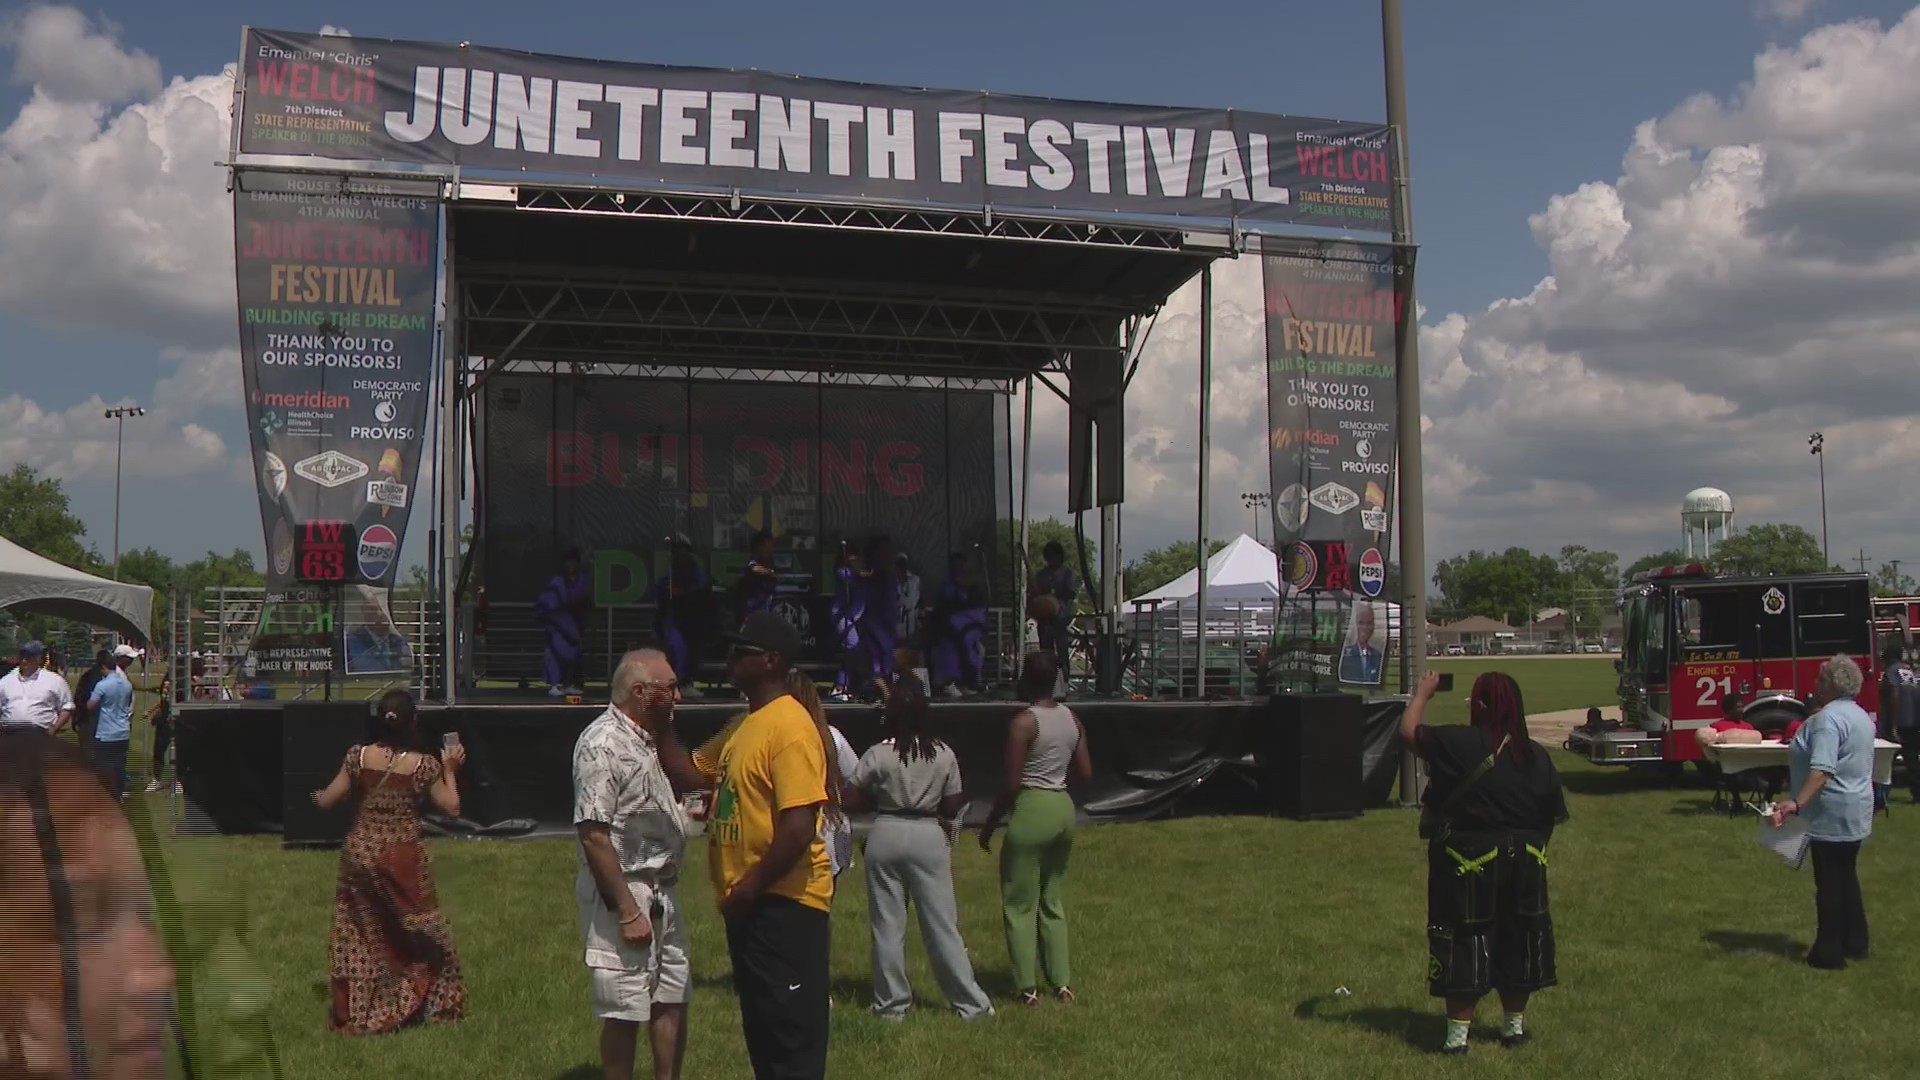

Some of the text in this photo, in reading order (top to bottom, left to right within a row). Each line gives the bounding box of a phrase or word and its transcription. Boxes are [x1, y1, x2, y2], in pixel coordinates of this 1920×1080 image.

[258, 45, 325, 60] Emanuel
[256, 58, 376, 105] WELCH
[284, 105, 343, 117] 7th District
[254, 113, 372, 132] STATE REPRESENTATIVE
[251, 128, 298, 140] SPEAKER
[384, 65, 1290, 205] JUNETEENTH FESTIVAL
[1295, 132, 1347, 146] Emanuel
[1295, 144, 1387, 185] WELCH
[287, 179, 392, 195] HOUSE SPEAKER
[1320, 183, 1365, 194] 7th District
[250, 192, 312, 204] EMANUEL
[371, 198, 427, 210] WELCH'S
[1299, 190, 1389, 208] STATE REPRESENTATIVE
[298, 205, 381, 219] 4TH ANNUAL
[242, 220, 430, 266] JUNETEENTH
[1323, 271, 1365, 282] ANNUAL
[1360, 263, 1404, 275] WELCH'S
[270, 264, 401, 306] FESTIVAL
[245, 308, 426, 330] BUILDING THE DREAM
[267, 334, 394, 352] THANK YOU TO
[263, 351, 401, 369] OUR SPONSORS!
[1320, 361, 1344, 374] THE
[1347, 363, 1394, 378] DREAM
[353, 380, 421, 391] DEMOCRATIC
[1322, 383, 1349, 396] YOU
[1352, 385, 1369, 397] TO
[264, 391, 350, 408] meridian
[371, 391, 404, 400] PARTY
[350, 427, 415, 440] PROVISO
[1339, 421, 1389, 431] DEMOCRATIC
[1352, 430, 1376, 438] PARTY
[546, 430, 925, 496] BUILDING
[1341, 461, 1389, 474] PROVISO
[304, 519, 347, 543] IW
[360, 544, 394, 559] PEPSI
[302, 550, 345, 580] 63
[1361, 565, 1382, 578] PEPSI
[282, 661, 293, 672] OF
[294, 661, 309, 671] THE
[309, 661, 333, 671] HOUSE
[1687, 666, 1720, 676] ENGINE
[1696, 676, 1732, 706] 21
